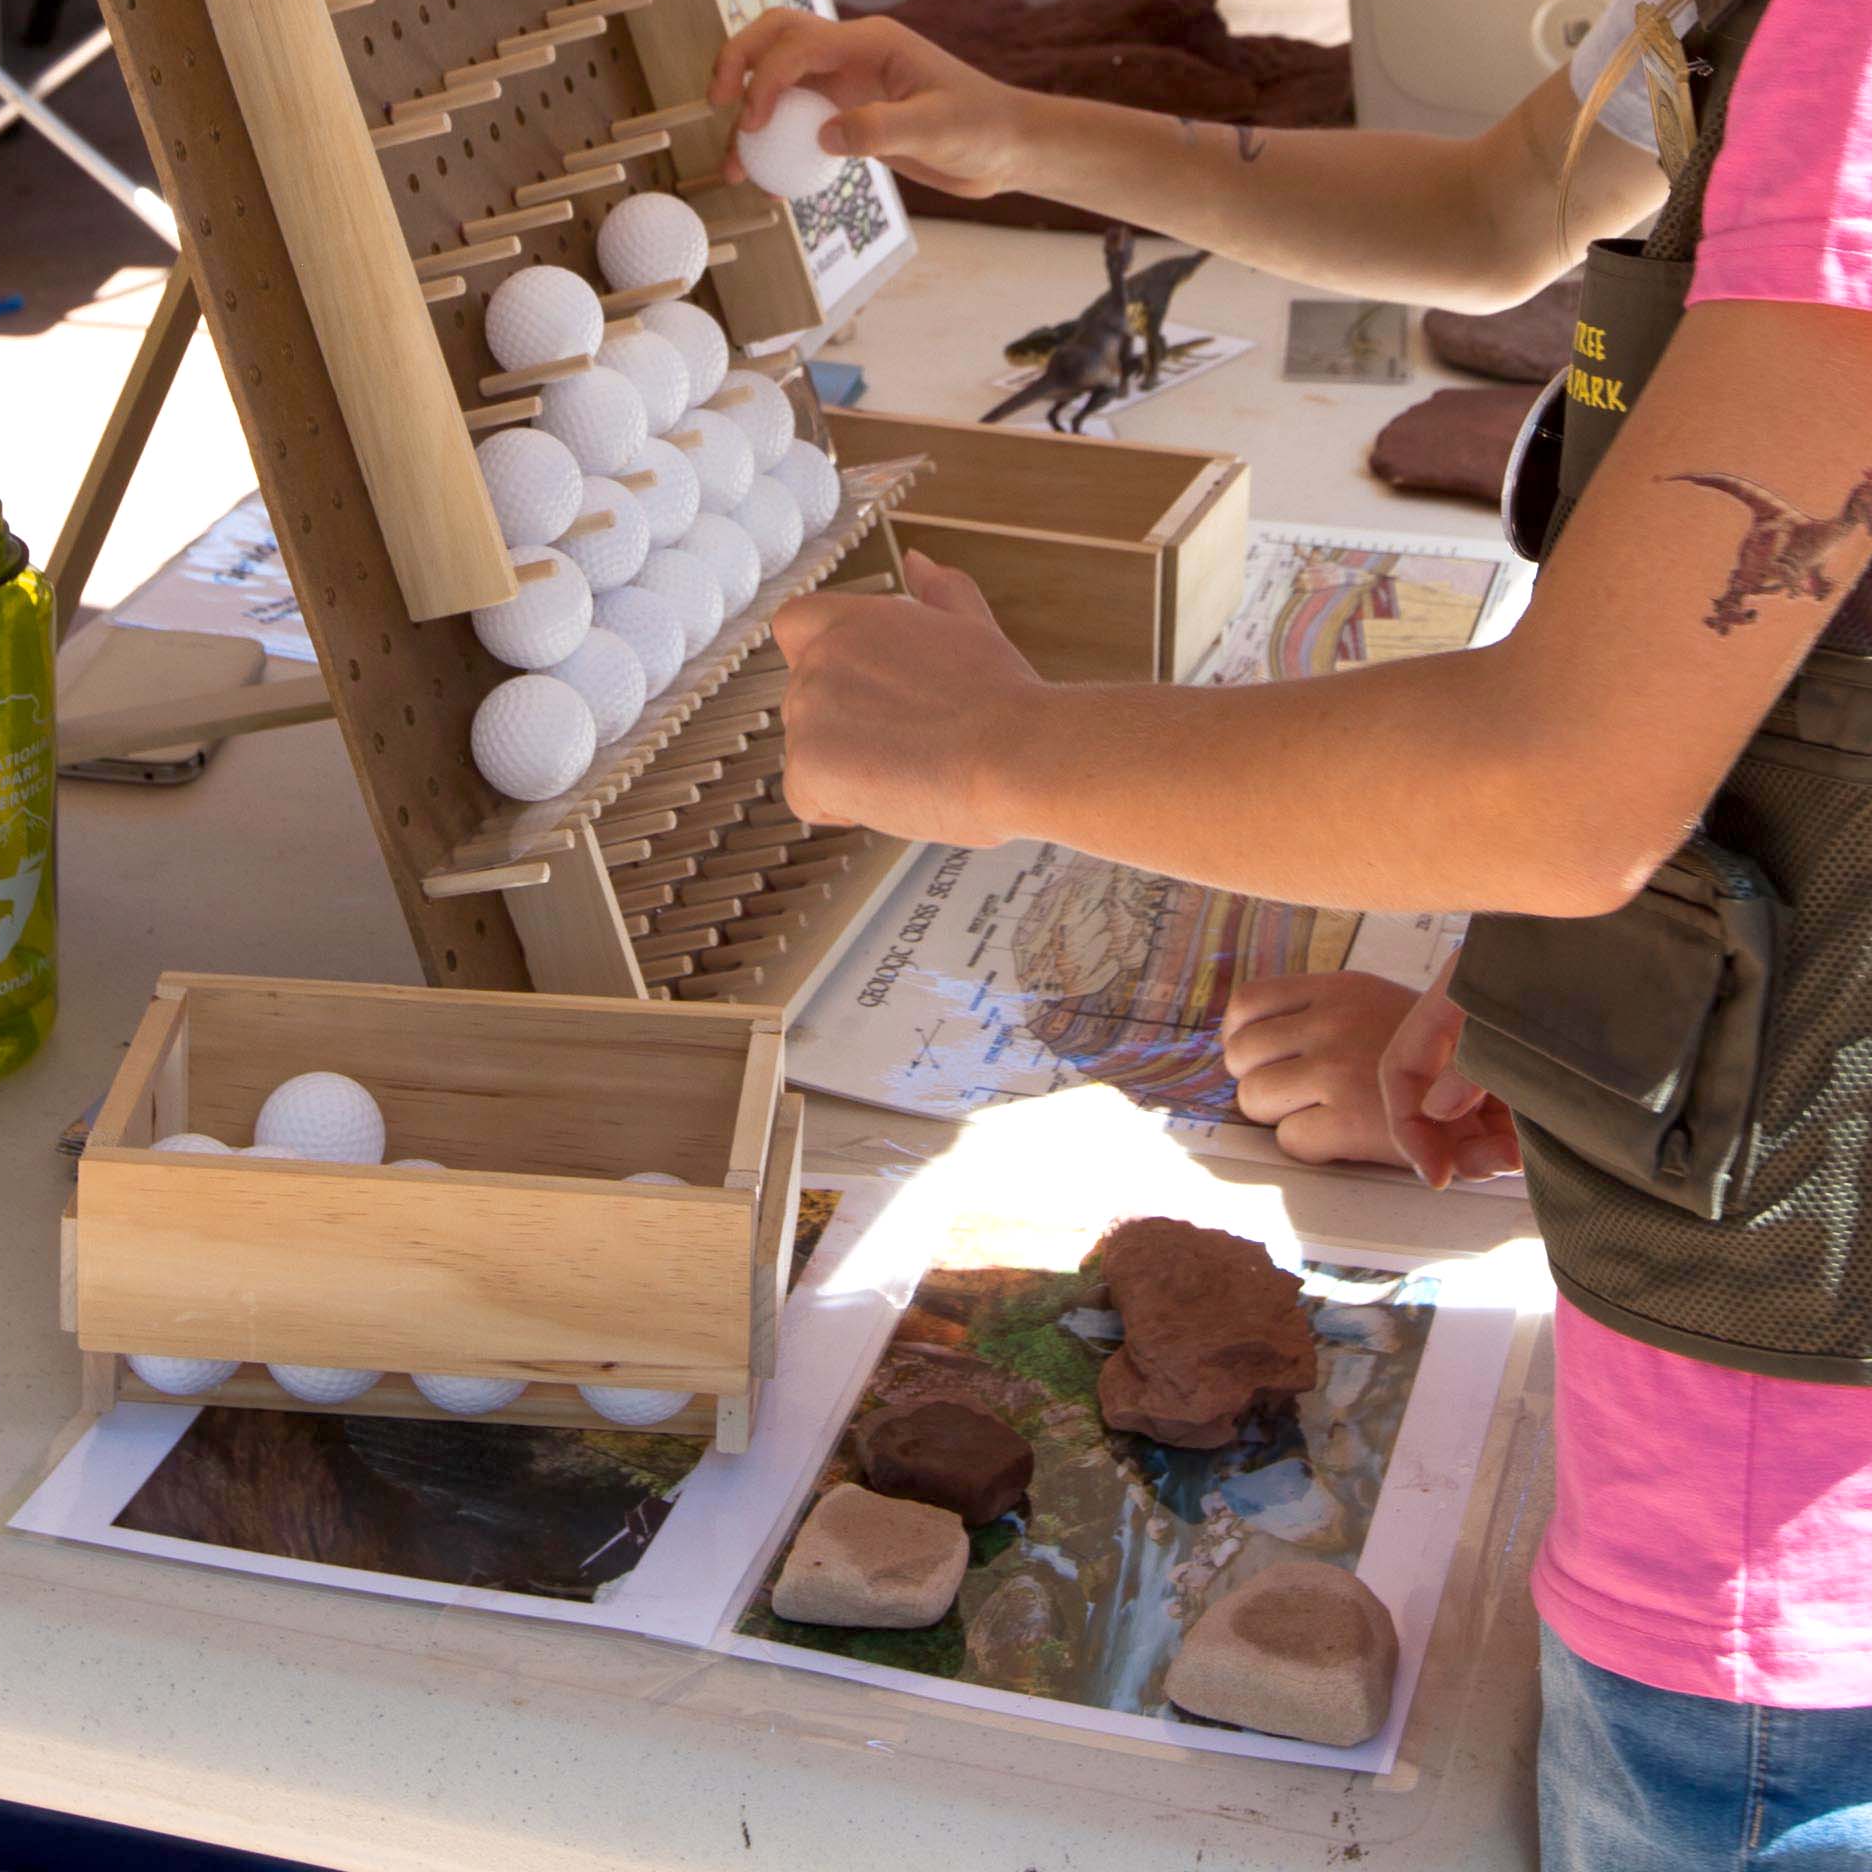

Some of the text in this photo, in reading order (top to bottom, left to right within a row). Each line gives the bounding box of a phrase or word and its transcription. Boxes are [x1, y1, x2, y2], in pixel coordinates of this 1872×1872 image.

[1572, 364, 1627, 412] PARK
[0, 762, 40, 791] PARK
[856, 847, 974, 1009] GEOLOGIC CROSS SECTION
